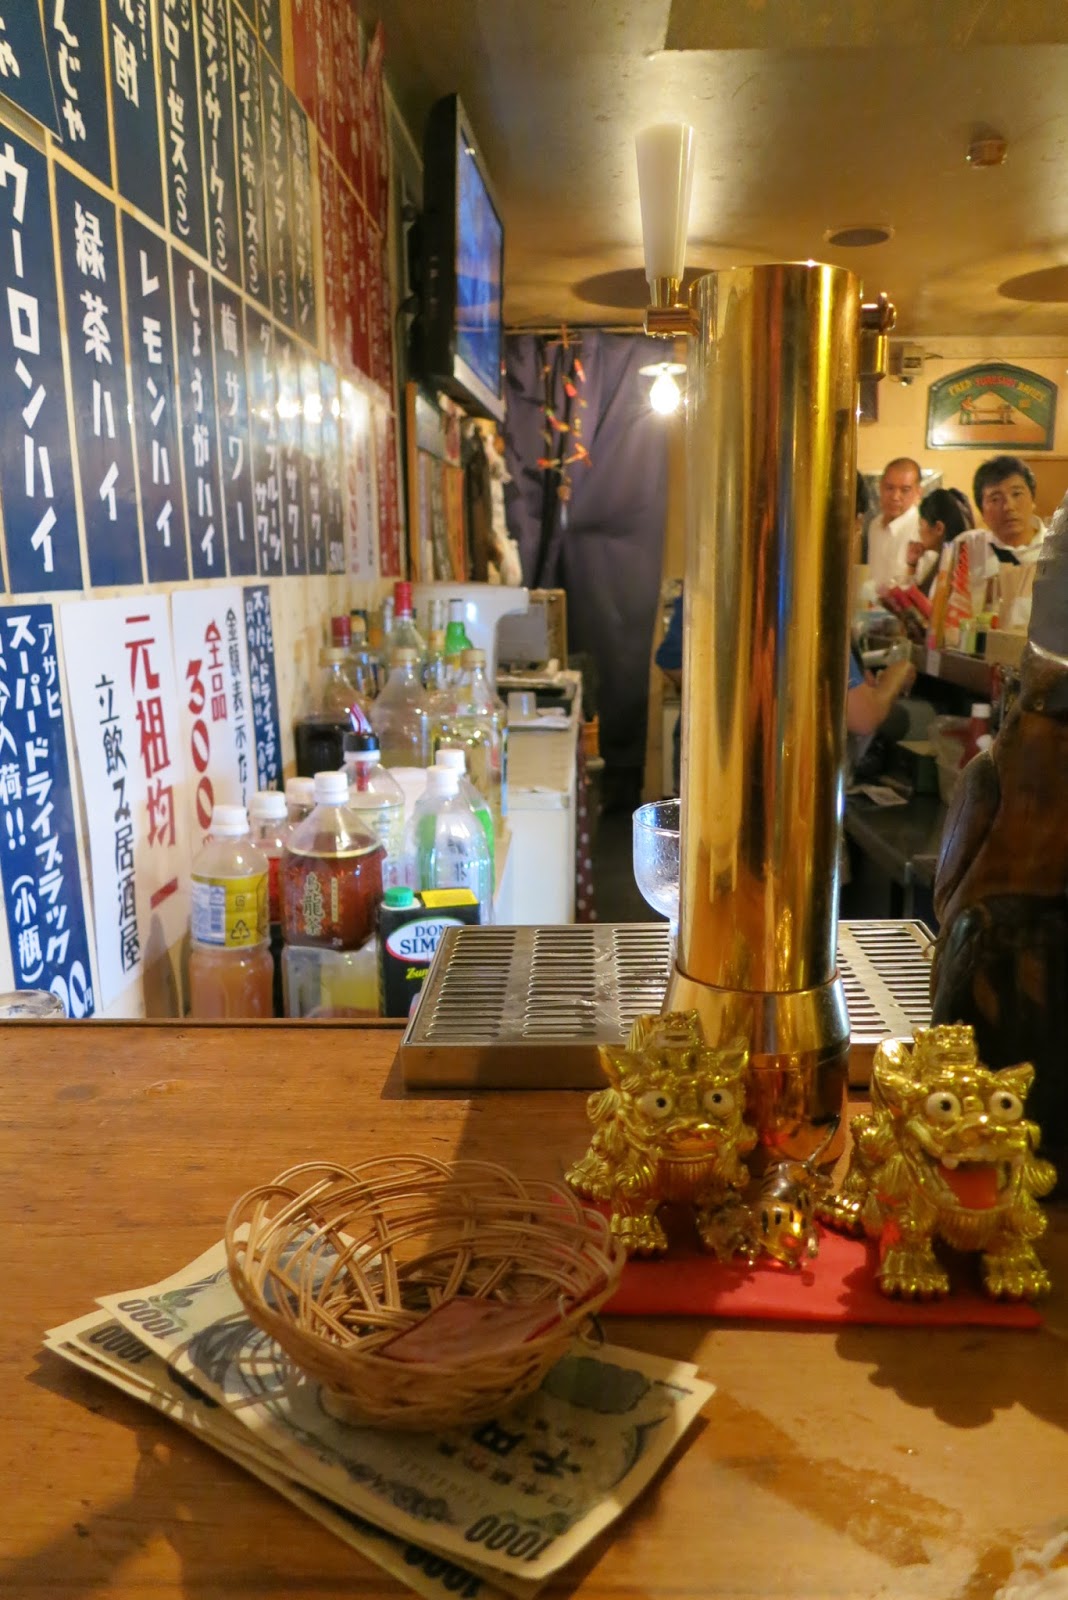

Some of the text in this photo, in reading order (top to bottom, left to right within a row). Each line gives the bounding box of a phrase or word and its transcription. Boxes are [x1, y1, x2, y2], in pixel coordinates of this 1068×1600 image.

[0, 143, 57, 574] ウーロンハイ
[74, 201, 118, 522] 緑茶ハイ
[139, 250, 173, 547] レモンハイ
[187, 269, 216, 566] しょうがハイ
[220, 303, 245, 541] 梅サワー
[38, 623, 61, 718] アサヒ
[124, 614, 178, 910] 元祖均一
[184, 659, 214, 846] 300
[95, 673, 141, 975] 立飲み居酒屋
[400, 937, 438, 955] SIM
[117, 1299, 183, 1340] 1000
[465, 1514, 554, 1562] 1000
